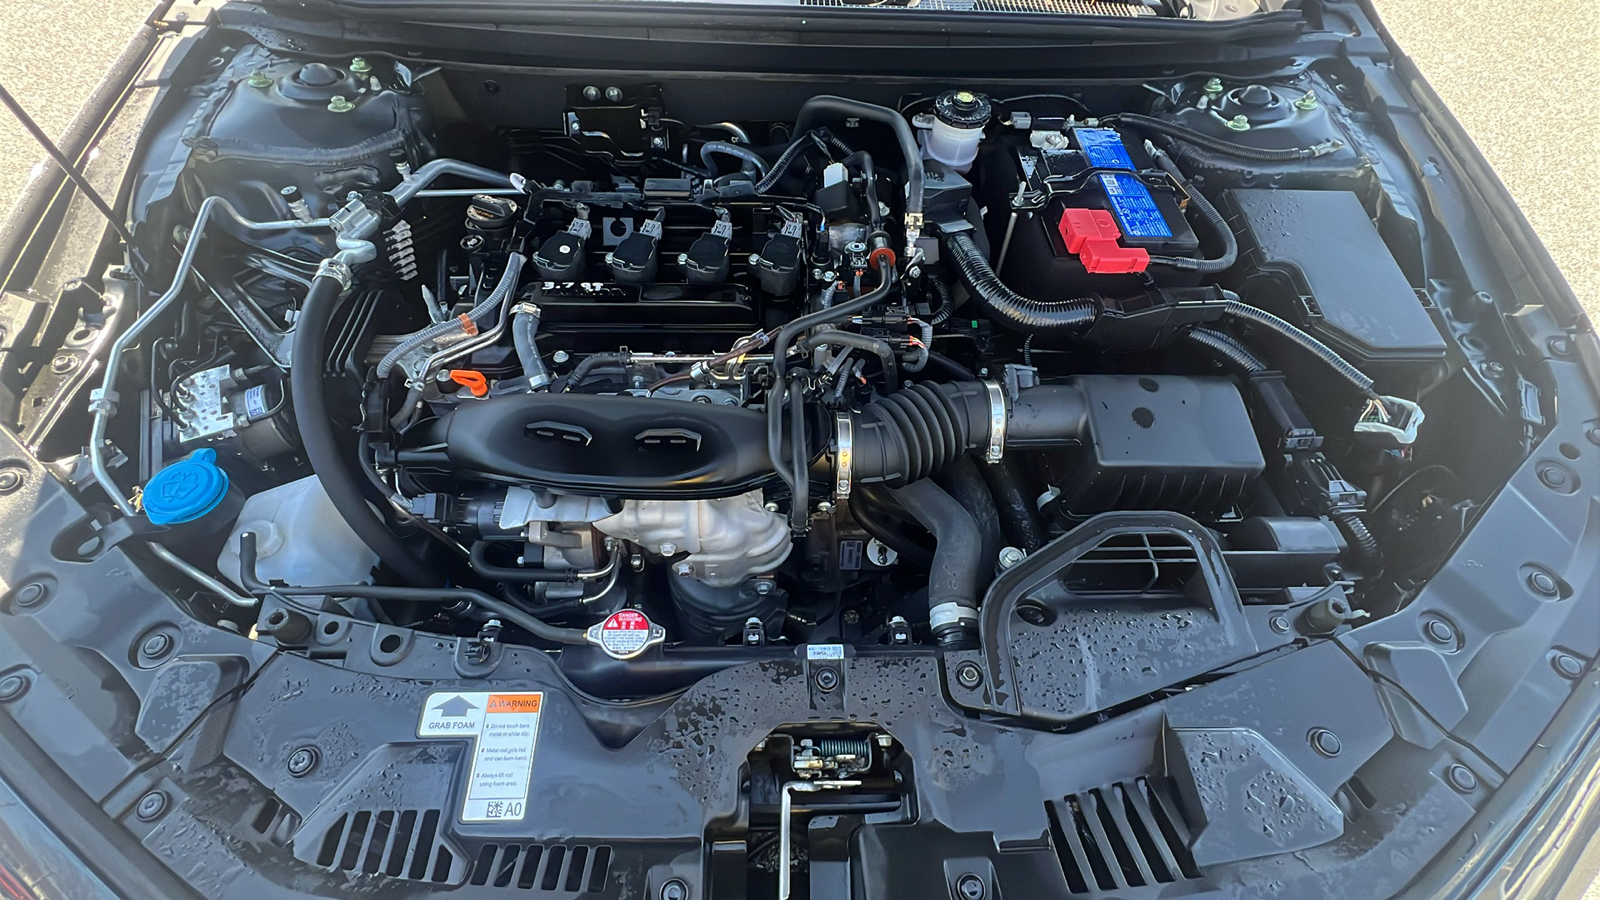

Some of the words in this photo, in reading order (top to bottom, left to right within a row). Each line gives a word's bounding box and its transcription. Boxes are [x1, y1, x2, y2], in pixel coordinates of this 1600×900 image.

[541, 281, 575, 290] 3.7
[499, 700, 538, 708] WARNING
[428, 721, 451, 729] GRAB
[452, 721, 475, 729] FOAM
[503, 801, 523, 817] A0
